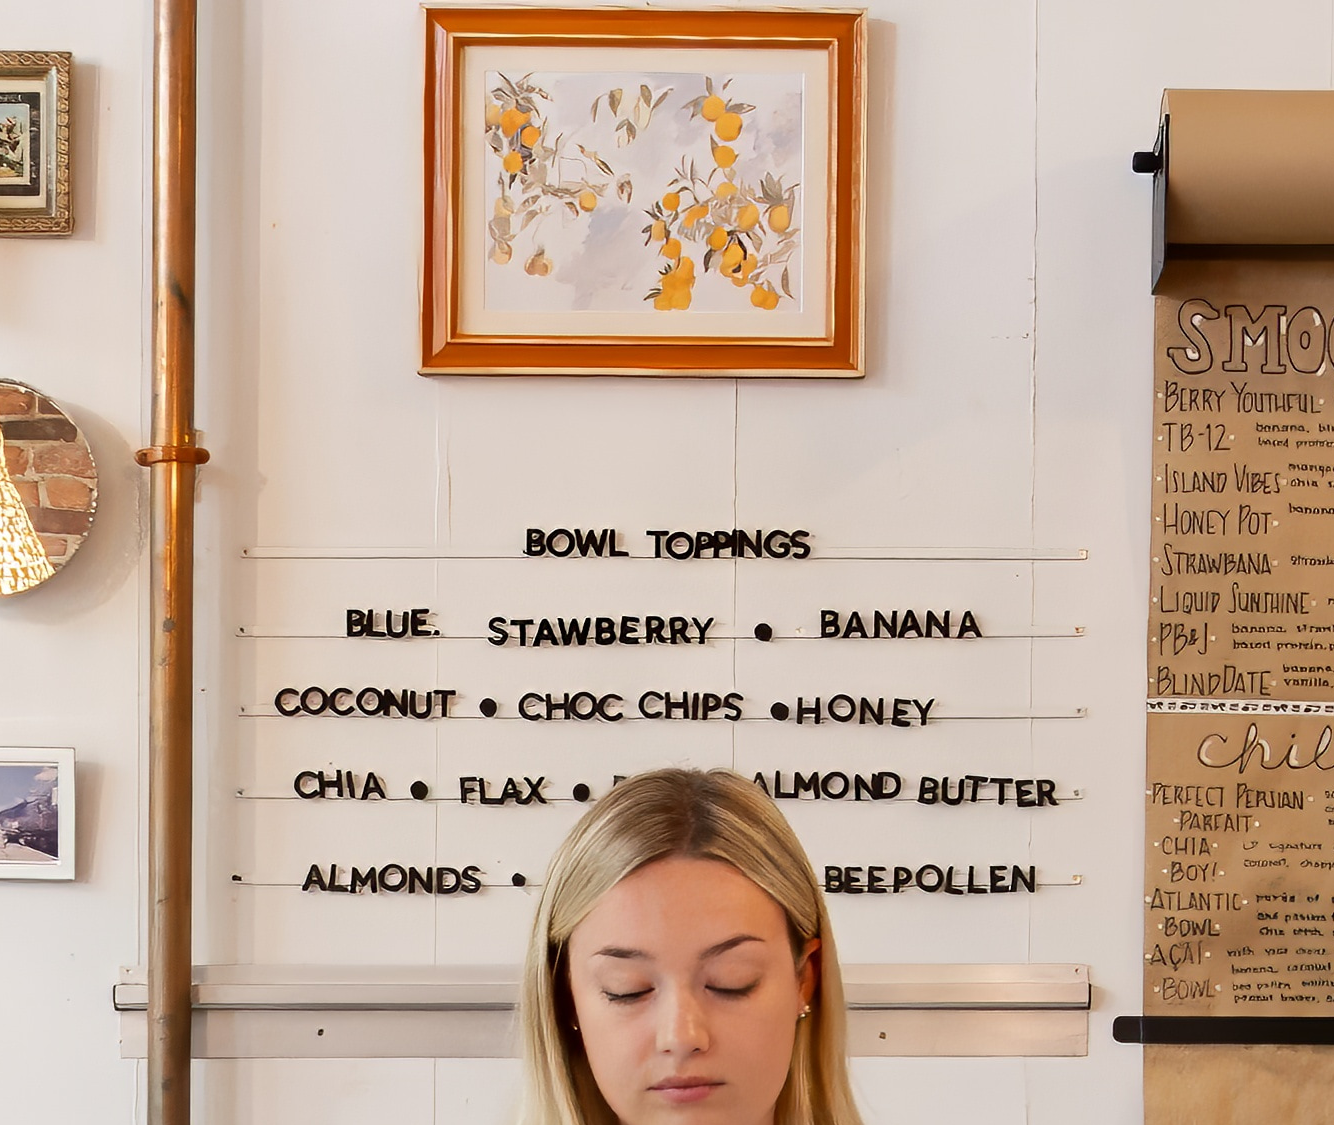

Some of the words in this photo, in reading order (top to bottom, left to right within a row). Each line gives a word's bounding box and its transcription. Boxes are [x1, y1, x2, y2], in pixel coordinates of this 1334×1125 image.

[1165, 380, 1226, 413] BERRY
[1230, 381, 1322, 414] YOUTHFUL
[1162, 423, 1231, 452] TB-12
[1165, 462, 1228, 494] ISLAND
[1233, 462, 1281, 495] VIBES
[1163, 502, 1231, 536] HONEY
[1238, 503, 1272, 536] POT
[524, 528, 629, 557] BOWL
[645, 529, 813, 560] TOPPINGS
[1161, 543, 1272, 576] STRAWBANA
[1160, 585, 1221, 615] LIQUID
[1228, 582, 1311, 615] SUNSHINE
[346, 608, 441, 638] BLUE.
[487, 615, 715, 647] STAWBERRY
[820, 609, 983, 639] BANANA
[1159, 622, 1208, 656] PB&J
[274, 686, 457, 717] COCONUT
[518, 691, 624, 721] CHOC
[638, 690, 744, 721] CHIPS
[796, 693, 936, 726] HONEY
[293, 769, 387, 801] CHIA
[459, 775, 549, 805] FLAX
[916, 774, 1060, 807] BUTTER
[1151, 782, 1225, 808] PERFECT
[1236, 782, 1305, 810] PERSIAN
[1179, 810, 1254, 833] PARFAIT
[1161, 836, 1212, 856] CHIA
[301, 862, 483, 894] ALMONDS
[1170, 861, 1218, 883] BOY!
[1150, 888, 1243, 912] ATLANTIC
[1164, 916, 1221, 938] BOWL
[1162, 976, 1216, 1001] BOWL
